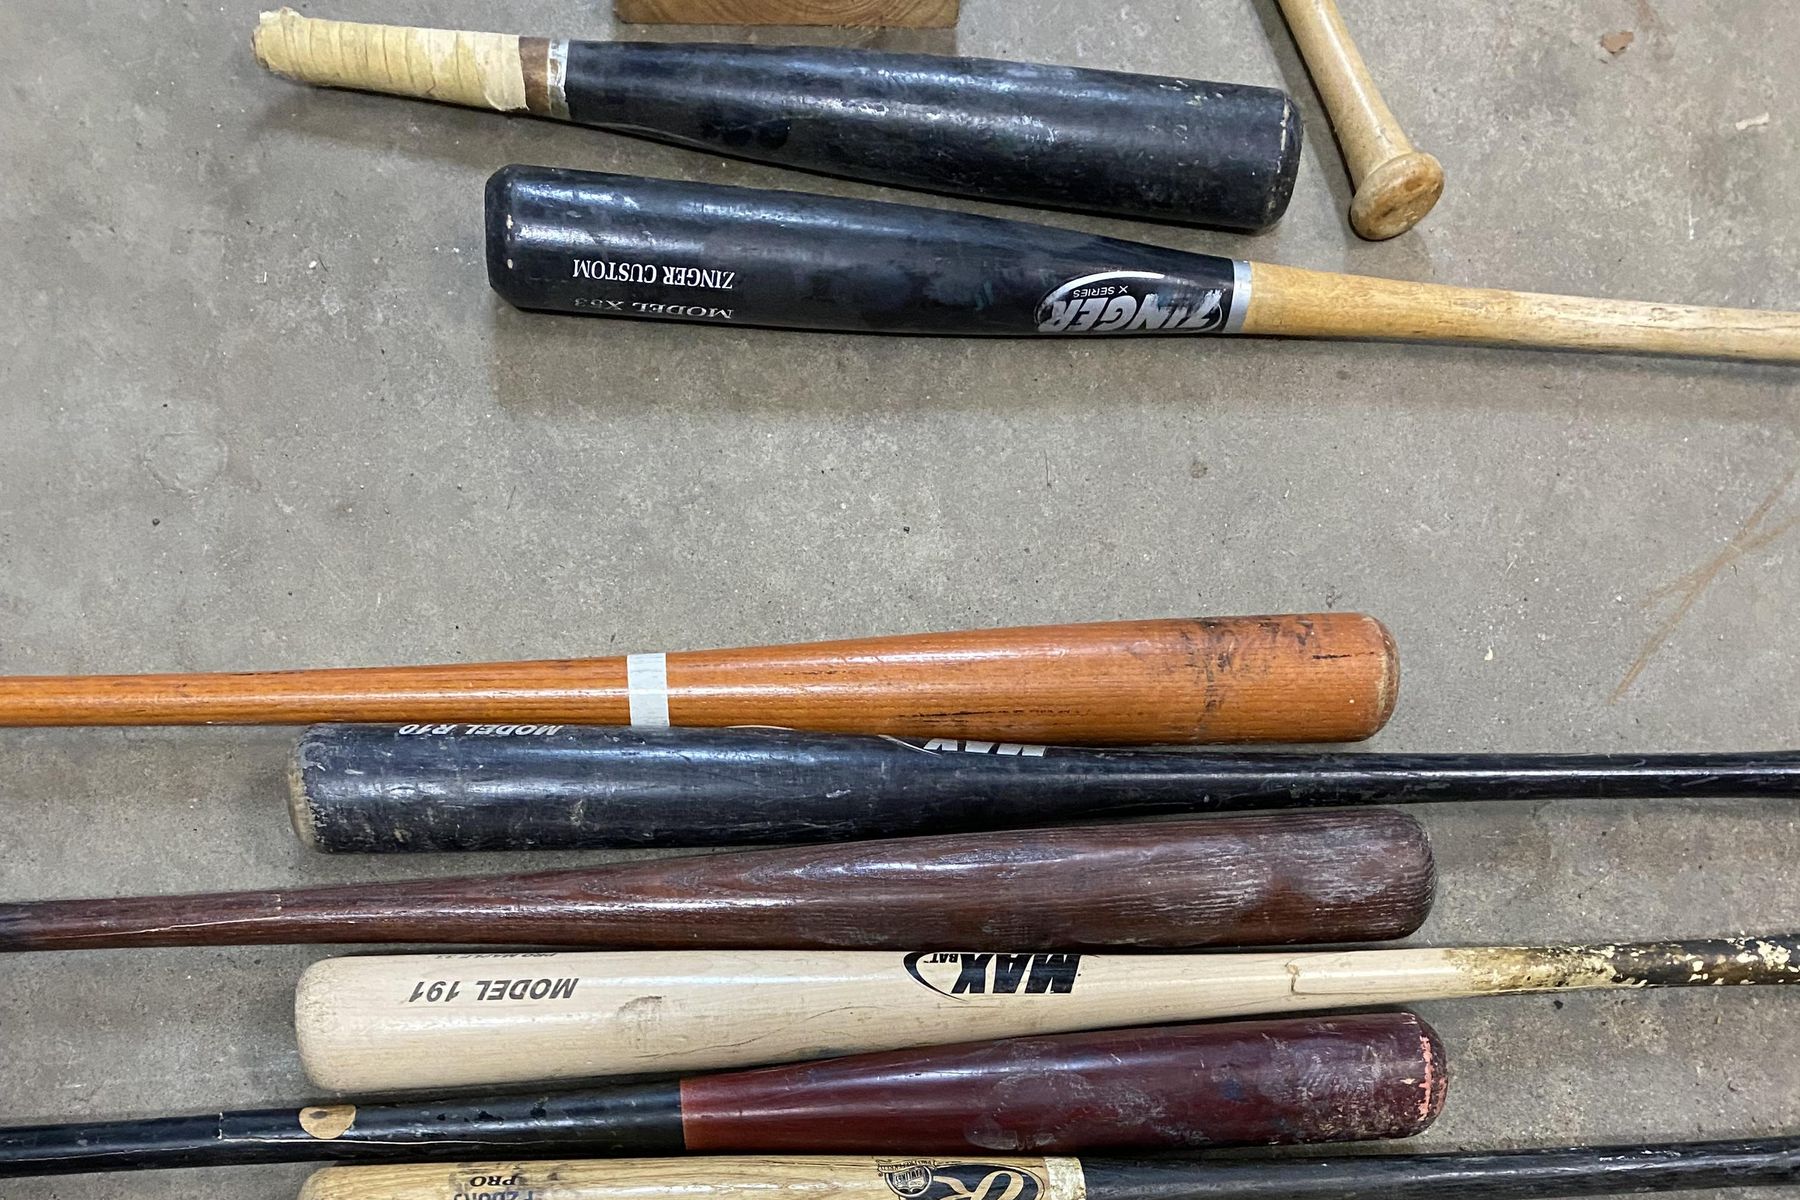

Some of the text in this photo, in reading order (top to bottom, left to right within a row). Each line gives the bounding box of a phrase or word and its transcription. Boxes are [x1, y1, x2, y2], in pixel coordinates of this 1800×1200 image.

[572, 258, 736, 290] ZINGER CUSTOM
[1072, 284, 1129, 299] X SERIES
[632, 301, 735, 319] MODEL
[398, 724, 564, 736] MODEL R10
[929, 953, 1082, 994] MAX BAT
[408, 977, 580, 1003] MODEL 191
[470, 1175, 519, 1188] PRO
